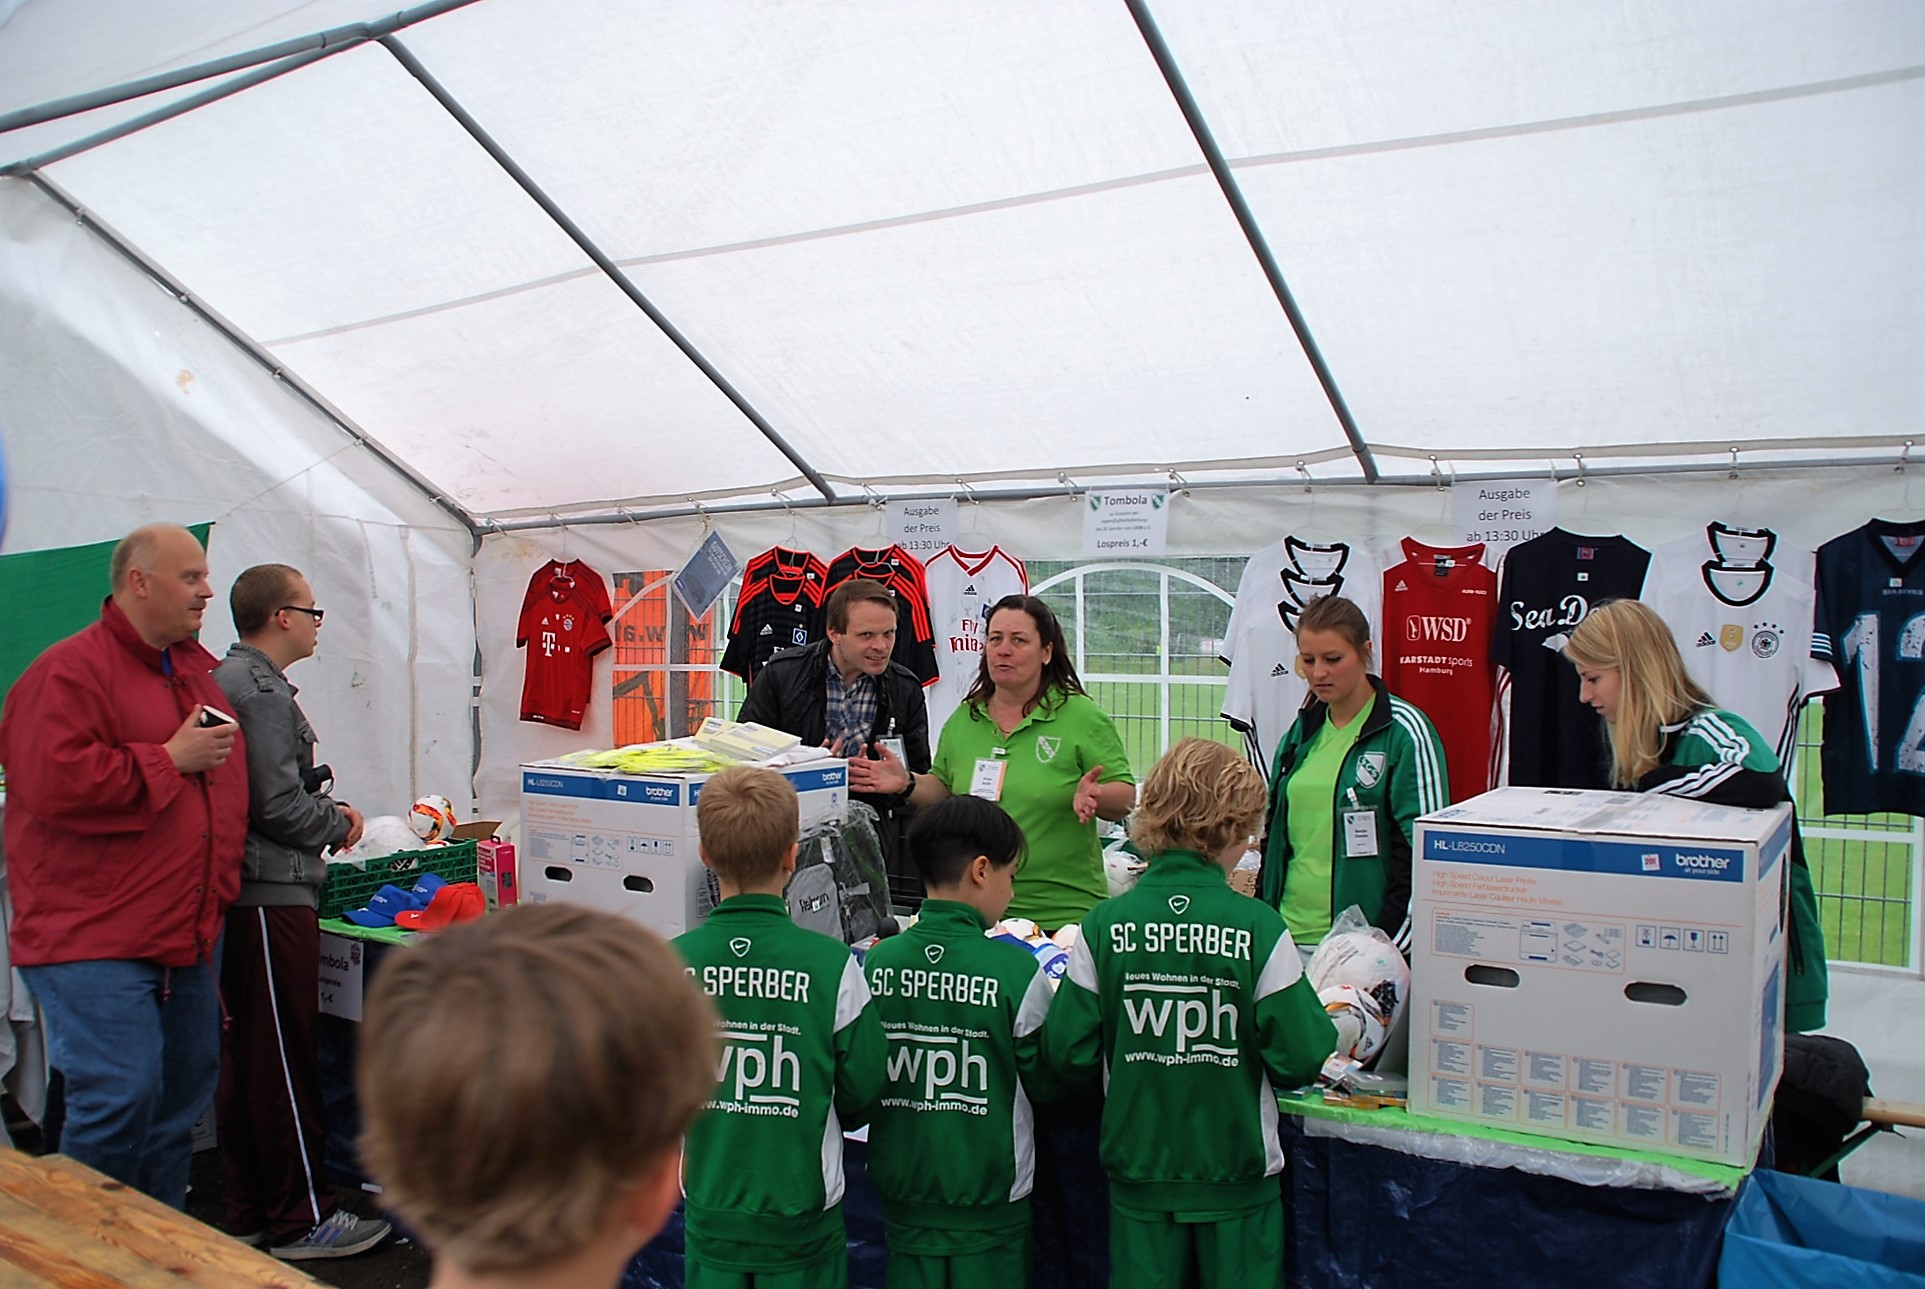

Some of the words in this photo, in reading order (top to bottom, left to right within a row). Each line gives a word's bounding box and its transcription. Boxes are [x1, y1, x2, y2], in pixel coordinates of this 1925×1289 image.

[1104, 495, 1147, 506] Tombola
[1479, 488, 1530, 501] Ausgabe
[904, 506, 939, 517] Ausgabe
[1478, 510, 1499, 521] der
[1502, 509, 1532, 520] Preis
[904, 524, 917, 533] der
[920, 523, 941, 532] Preis
[1467, 531, 1481, 541] ab
[1485, 530, 1518, 541] 13:30
[910, 540, 932, 550] 13:30
[1097, 539, 1130, 550] Lospreis
[1511, 601, 1556, 630] Sea
[962, 619, 978, 634] Fly
[1448, 657, 1473, 667] sports
[1419, 667, 1453, 675] Hamburg
[646, 786, 673, 797] brother
[1434, 840, 1506, 854] HL-L8250CDN
[1676, 853, 1730, 869] brother
[1111, 922, 1137, 953] SC
[1145, 923, 1250, 960] SPERBER
[703, 966, 810, 1003] SPERBER
[1152, 972, 1188, 982] Wohnen
[1189, 974, 1198, 983] in
[1200, 975, 1214, 984] der
[1215, 978, 1241, 989] Stadt.
[871, 968, 894, 996] SC
[901, 968, 998, 1007] SPERBER
[1124, 989, 1238, 1052] wph
[749, 1021, 758, 1031] in
[760, 1022, 776, 1032] der
[777, 1024, 801, 1035] Stadt.
[951, 1026, 964, 1035] der
[965, 1029, 989, 1038] Stadt.
[1125, 1051, 1239, 1067] www.wph-immo.de
[887, 1039, 987, 1100] wph
